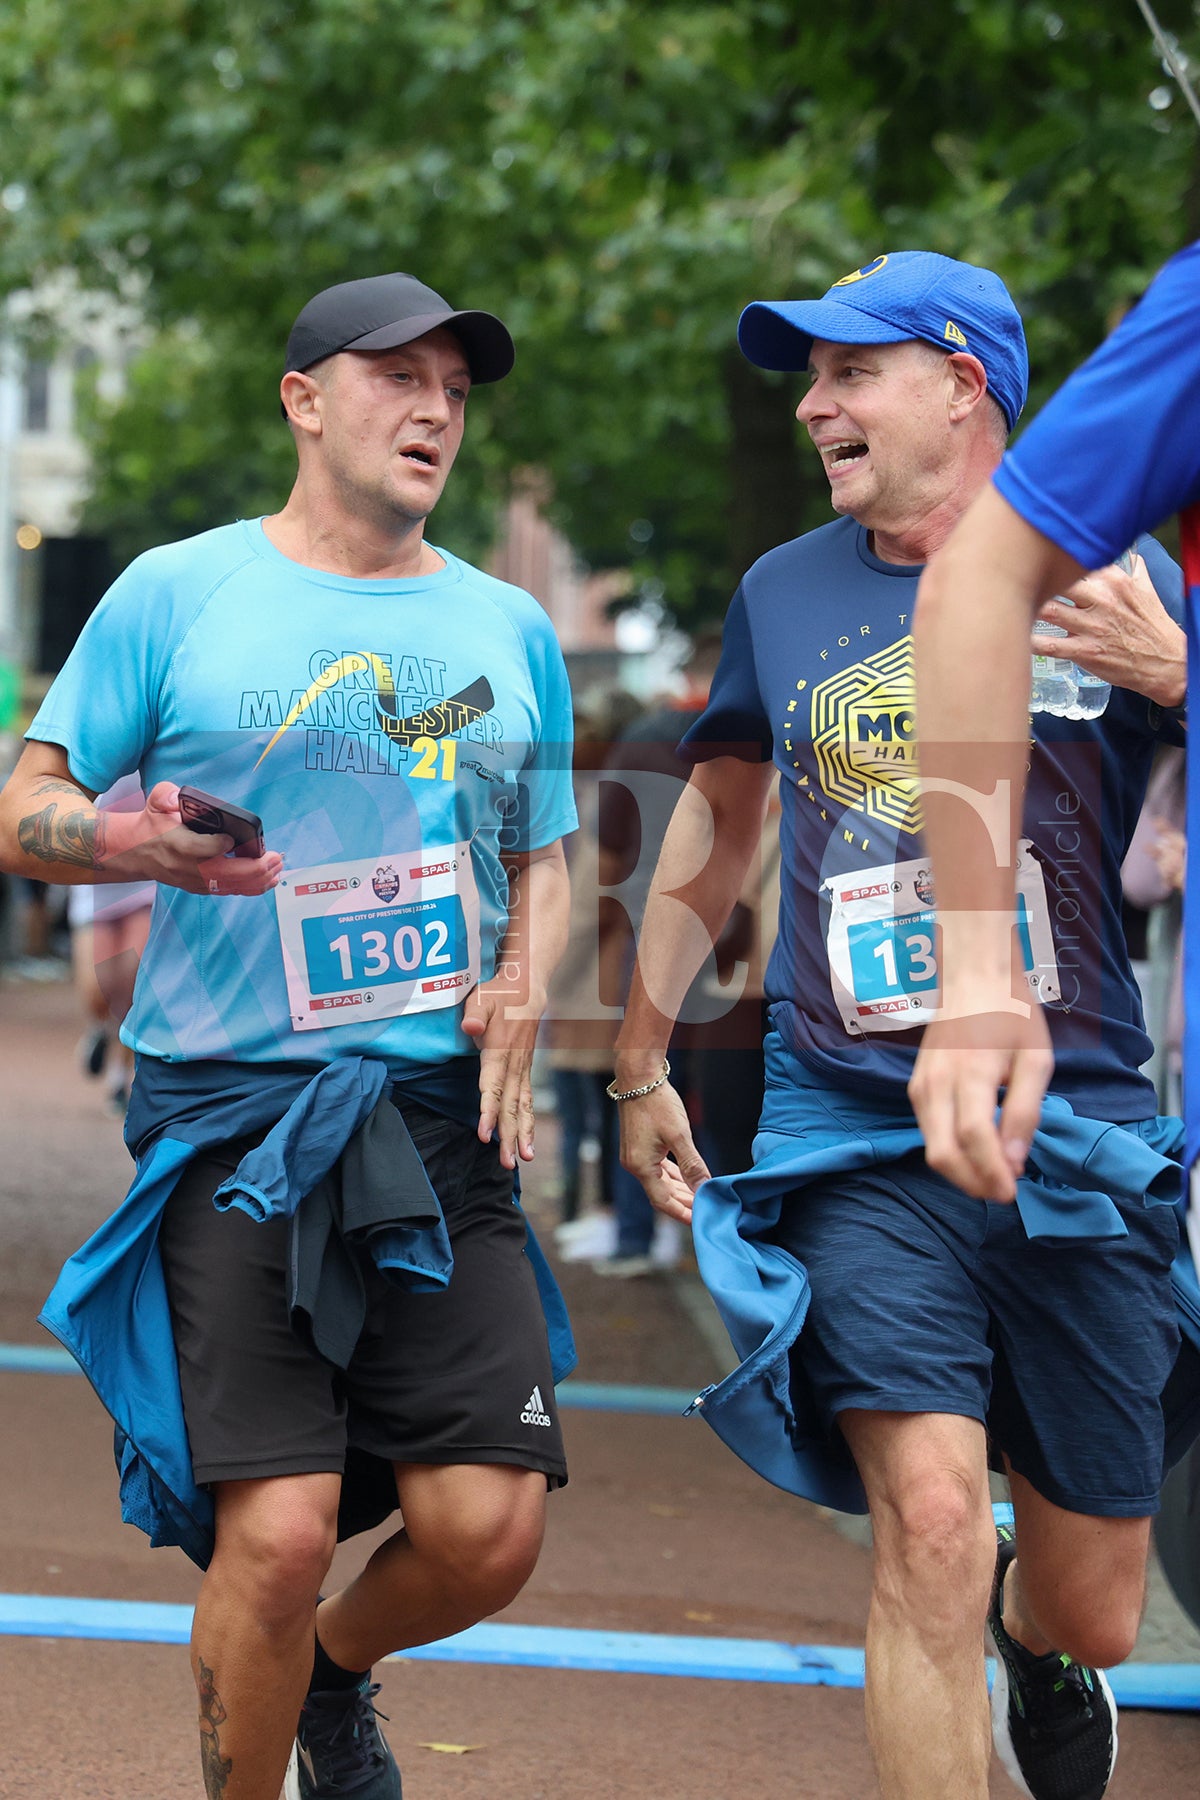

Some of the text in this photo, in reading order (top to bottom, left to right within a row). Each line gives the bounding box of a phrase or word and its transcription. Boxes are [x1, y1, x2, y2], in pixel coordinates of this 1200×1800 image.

[820, 625, 871, 661] FOR
[309, 649, 446, 696] GREAT
[238, 690, 504, 755] MANCHESTER
[857, 711, 917, 741] MC
[305, 729, 457, 781] HALF 21
[421, 863, 450, 877] SPAR
[308, 880, 347, 894] SPAR
[852, 884, 888, 899] SPAR
[376, 909, 401, 918] PRESTON
[329, 920, 451, 981] 1302
[874, 934, 938, 987] 13
[433, 977, 463, 990] SPAR
[323, 994, 361, 1008] SPAR
[869, 1000, 908, 1013] SPAR
[520, 1410, 551, 1427] adidas
